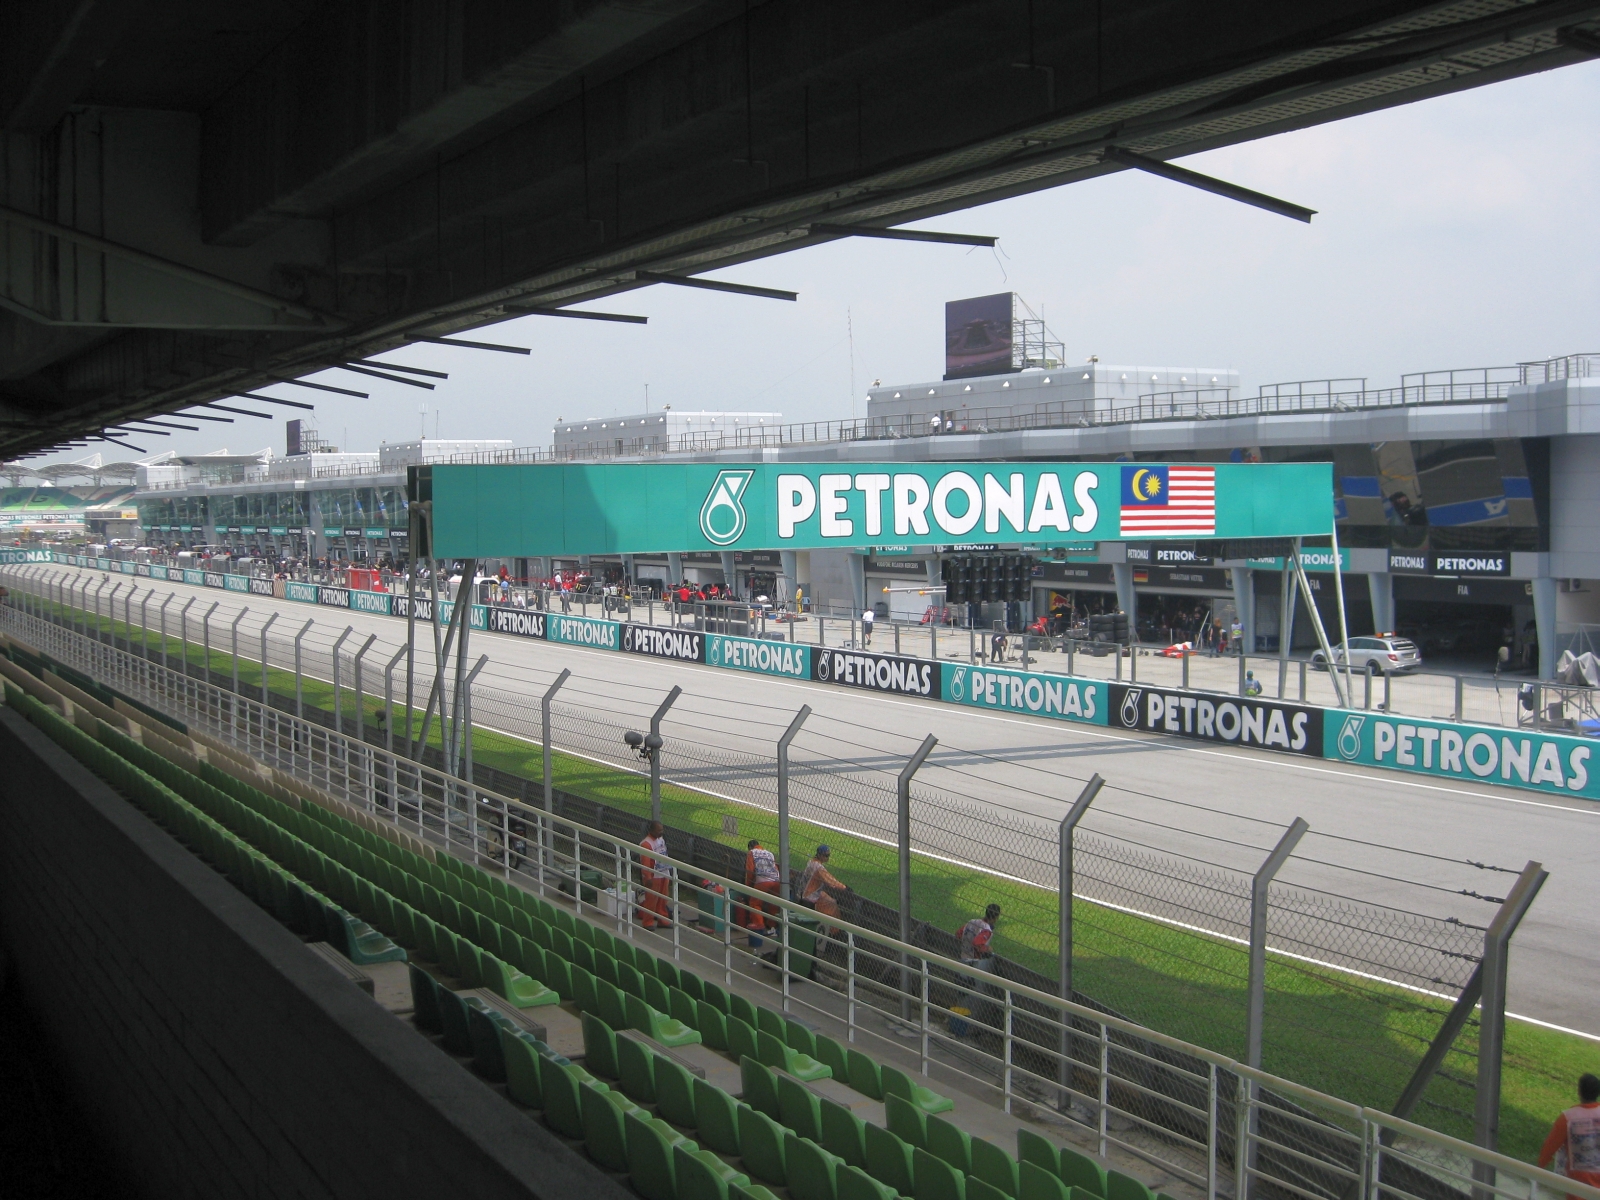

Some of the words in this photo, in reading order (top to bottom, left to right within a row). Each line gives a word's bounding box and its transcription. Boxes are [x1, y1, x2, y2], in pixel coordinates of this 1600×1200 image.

[777, 471, 1099, 538] PETRONAS
[0, 550, 52, 562] TRONAS
[1127, 549, 1149, 560] PETRONAS
[1157, 550, 1207, 561] PETRON
[1288, 554, 1343, 566] TRONAS
[1391, 556, 1425, 570] PETRONAS
[1437, 557, 1503, 572] PETRONAS
[290, 584, 315, 602] PETRONAS
[1310, 579, 1321, 590] FIA
[1457, 584, 1469, 595] FIA
[322, 588, 349, 607] PETRONAS
[357, 594, 388, 613] PETRONAS
[398, 598, 432, 620] PETONAS
[497, 610, 544, 637] PETRONAS
[560, 618, 615, 648] PETRONAS
[635, 627, 700, 660] PETRONAS
[724, 640, 803, 676] PETRONAS
[834, 653, 931, 695] PETRONAS
[971, 671, 1097, 719] PETRONAS
[1147, 692, 1309, 750] PETRONAS
[1373, 721, 1591, 791] PETRONAS
